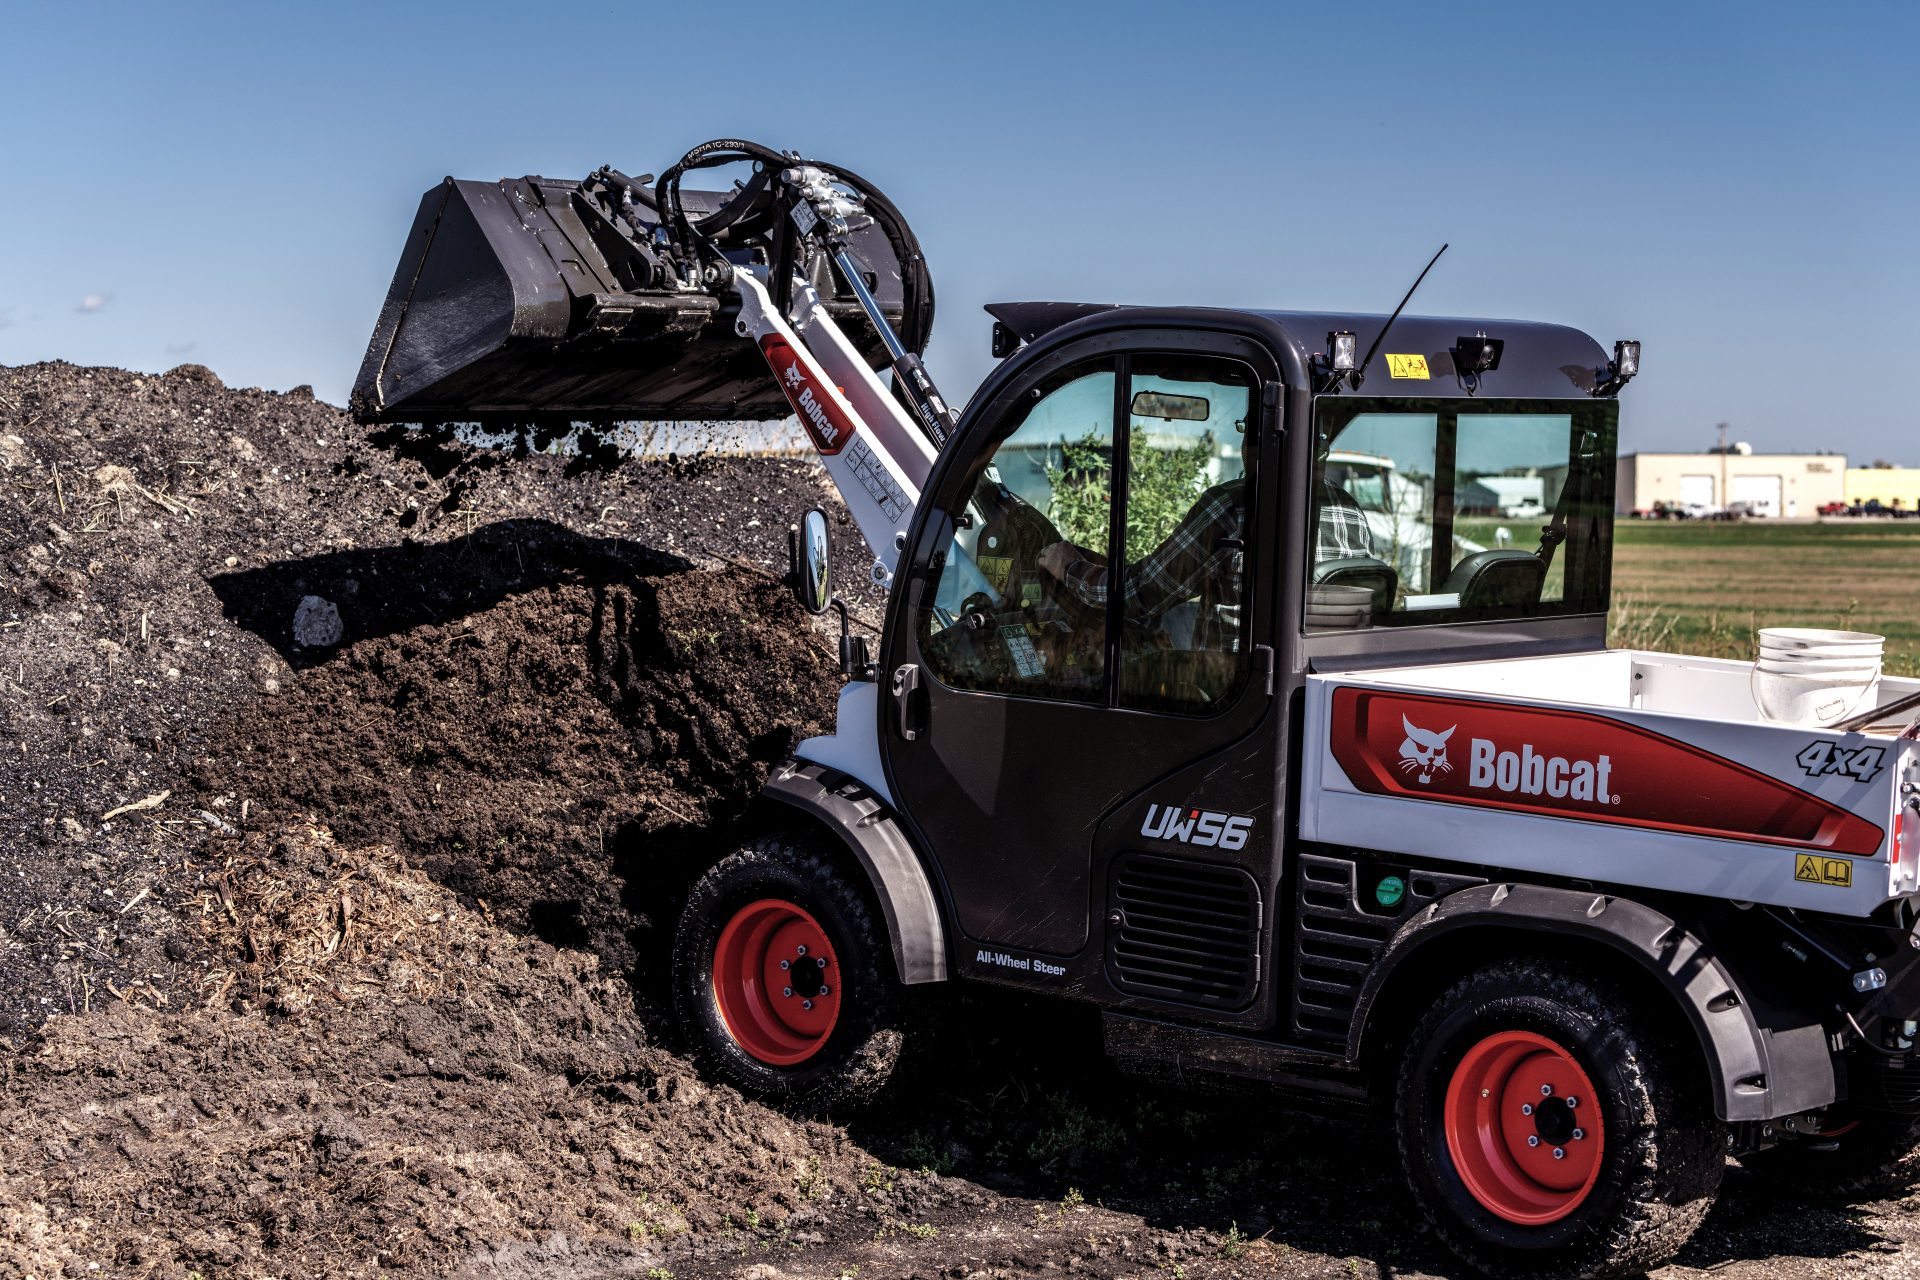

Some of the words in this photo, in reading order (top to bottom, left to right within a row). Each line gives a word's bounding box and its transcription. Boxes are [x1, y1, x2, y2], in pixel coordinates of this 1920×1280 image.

[798, 387, 839, 444] Bobcat
[921, 402, 935, 423] High
[931, 420, 946, 442] Flow
[1469, 738, 1612, 804] Bobcat
[1796, 740, 1887, 783] 4x4
[976, 950, 1030, 970] All-Wheel
[1033, 959, 1066, 976] Steer
